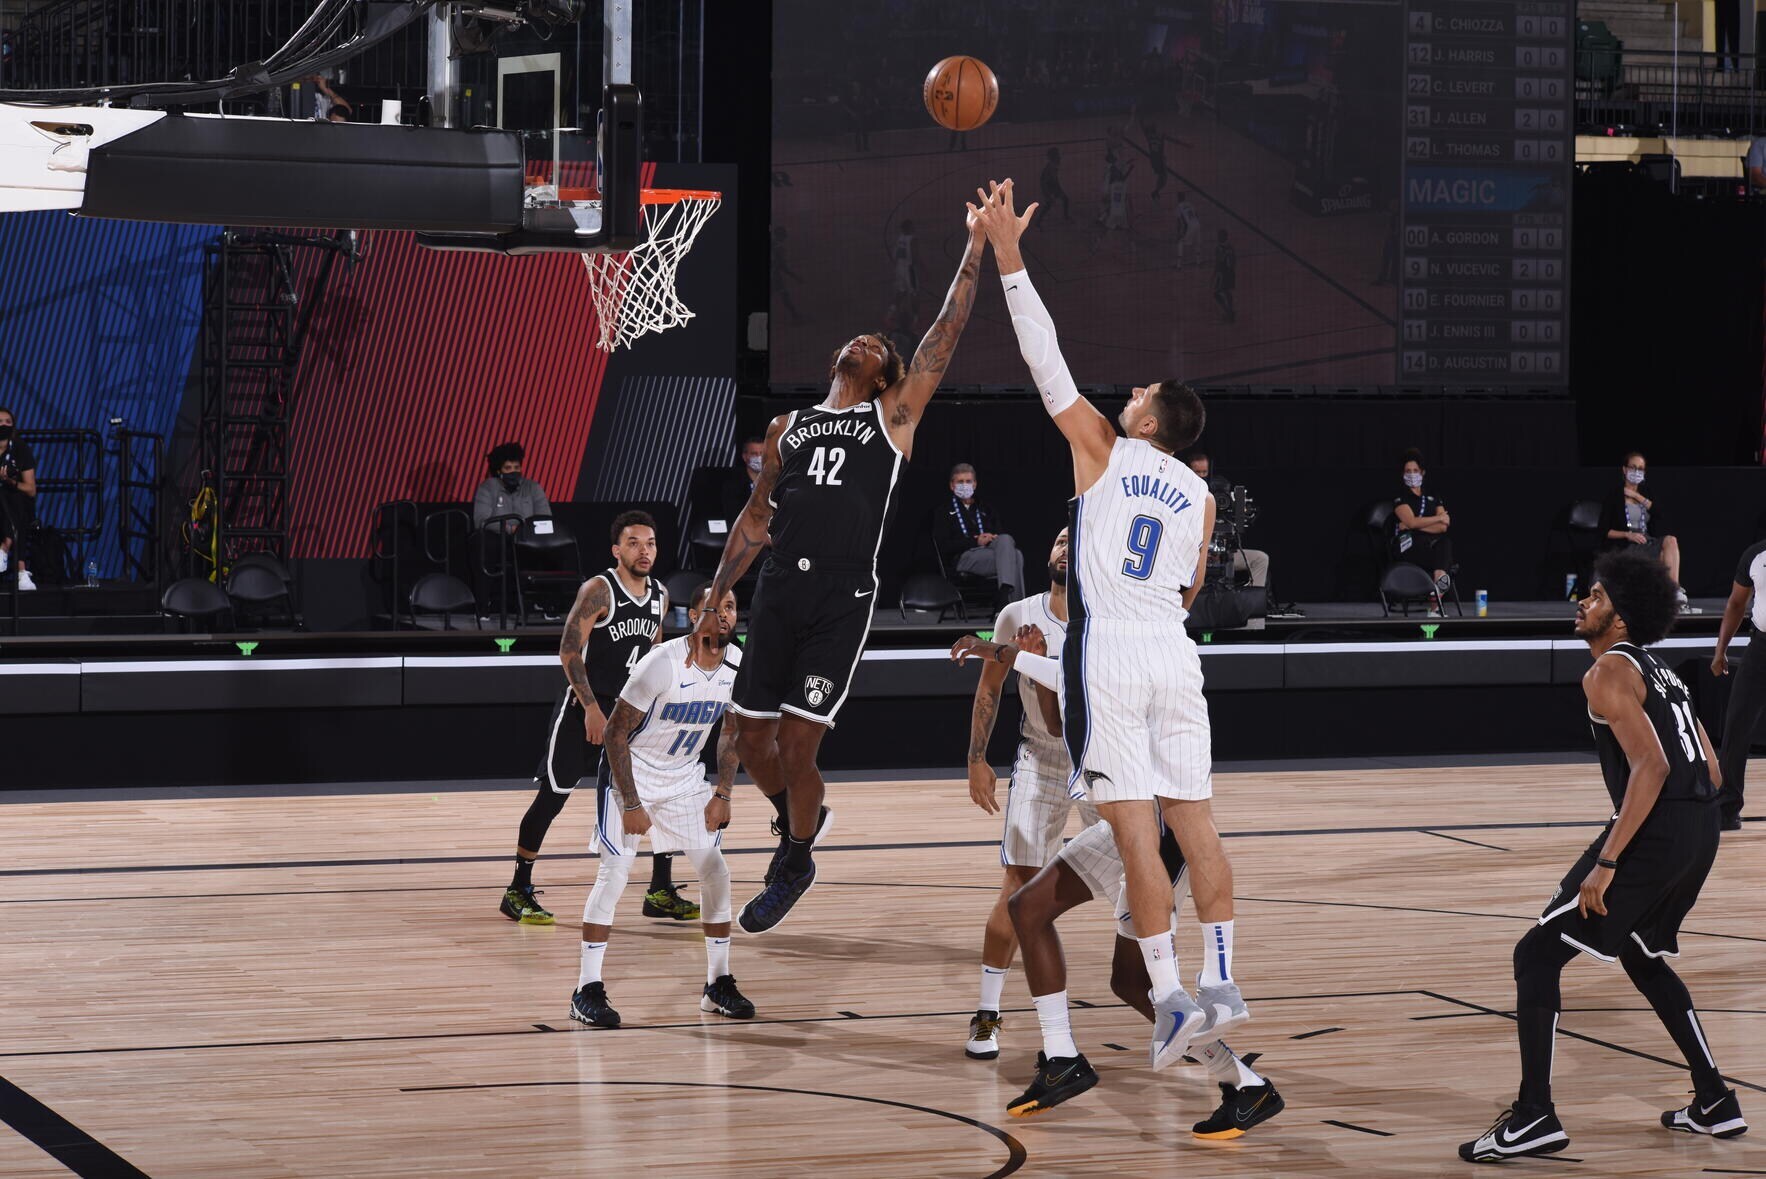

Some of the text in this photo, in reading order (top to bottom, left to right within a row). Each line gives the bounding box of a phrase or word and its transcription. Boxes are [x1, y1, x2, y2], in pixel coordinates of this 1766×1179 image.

[1416, 16, 1557, 34] 4 C. CHIOZZA 0 0
[1410, 47, 1557, 65] 12 J. HARRIS 0 0
[1410, 78, 1557, 96] 22 C. LEVERT 0 0
[1409, 110, 1556, 128] 31 J. ALLEN 2 0
[1408, 141, 1556, 158] 42 L. THOMAS 0 0
[1409, 178, 1496, 204] MAGIC
[1408, 229, 1554, 246] 00 A. GORDON 0 0
[1411, 261, 1554, 278] 9 N. VUCEVIC 2 0
[1407, 293, 1553, 308] 10 E. FOURNIER 0 0
[1407, 324, 1552, 339] 11 J. ENNIS III 0 0
[1406, 355, 1552, 370] 14 D. AUGUSTIN 0 0
[786, 419, 876, 450] BROOKLYN
[807, 446, 846, 486] 42
[1121, 475, 1192, 514] EQUALITY
[1121, 514, 1164, 581] 9
[806, 677, 832, 694] NETS
[1670, 701, 1707, 762] 31
[667, 729, 704, 756] 14
